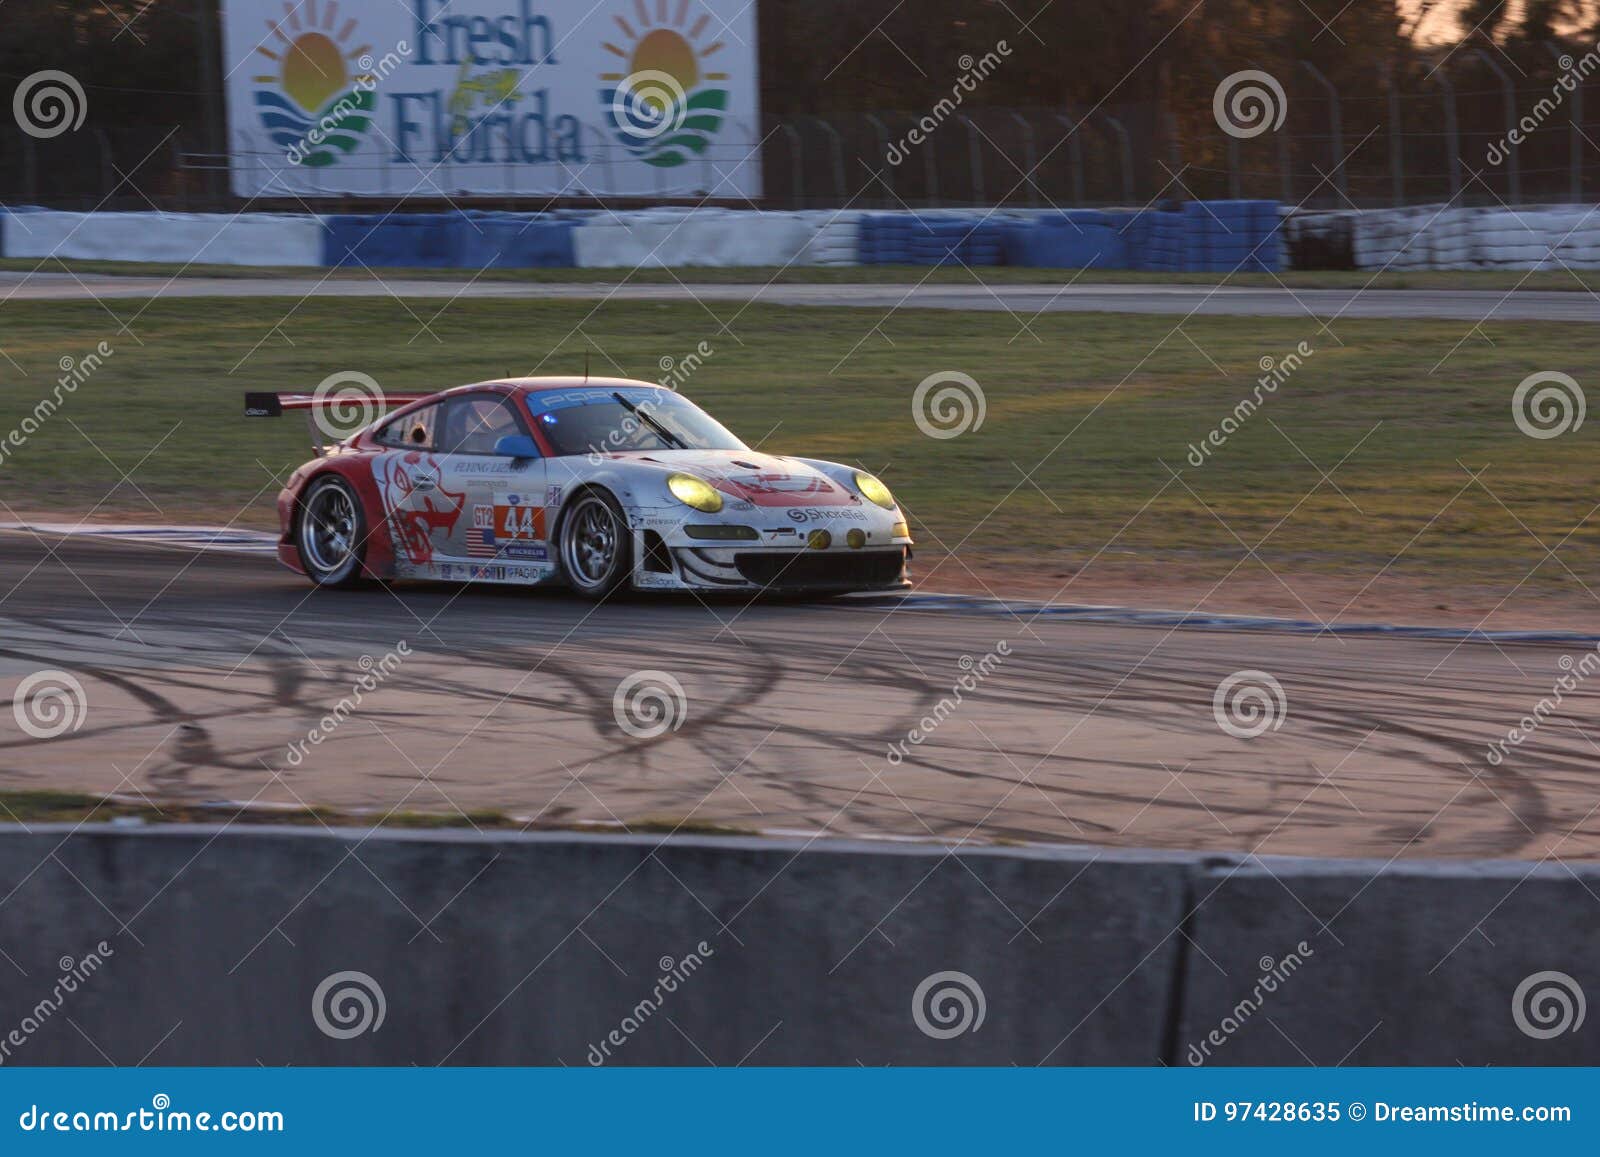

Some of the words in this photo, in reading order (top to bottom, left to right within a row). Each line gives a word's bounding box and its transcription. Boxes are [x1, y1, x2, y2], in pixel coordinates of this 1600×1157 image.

[410, 0, 558, 65] Fresh
[386, 88, 583, 163] Florida
[474, 506, 494, 526] GT2
[503, 507, 536, 539] 44
